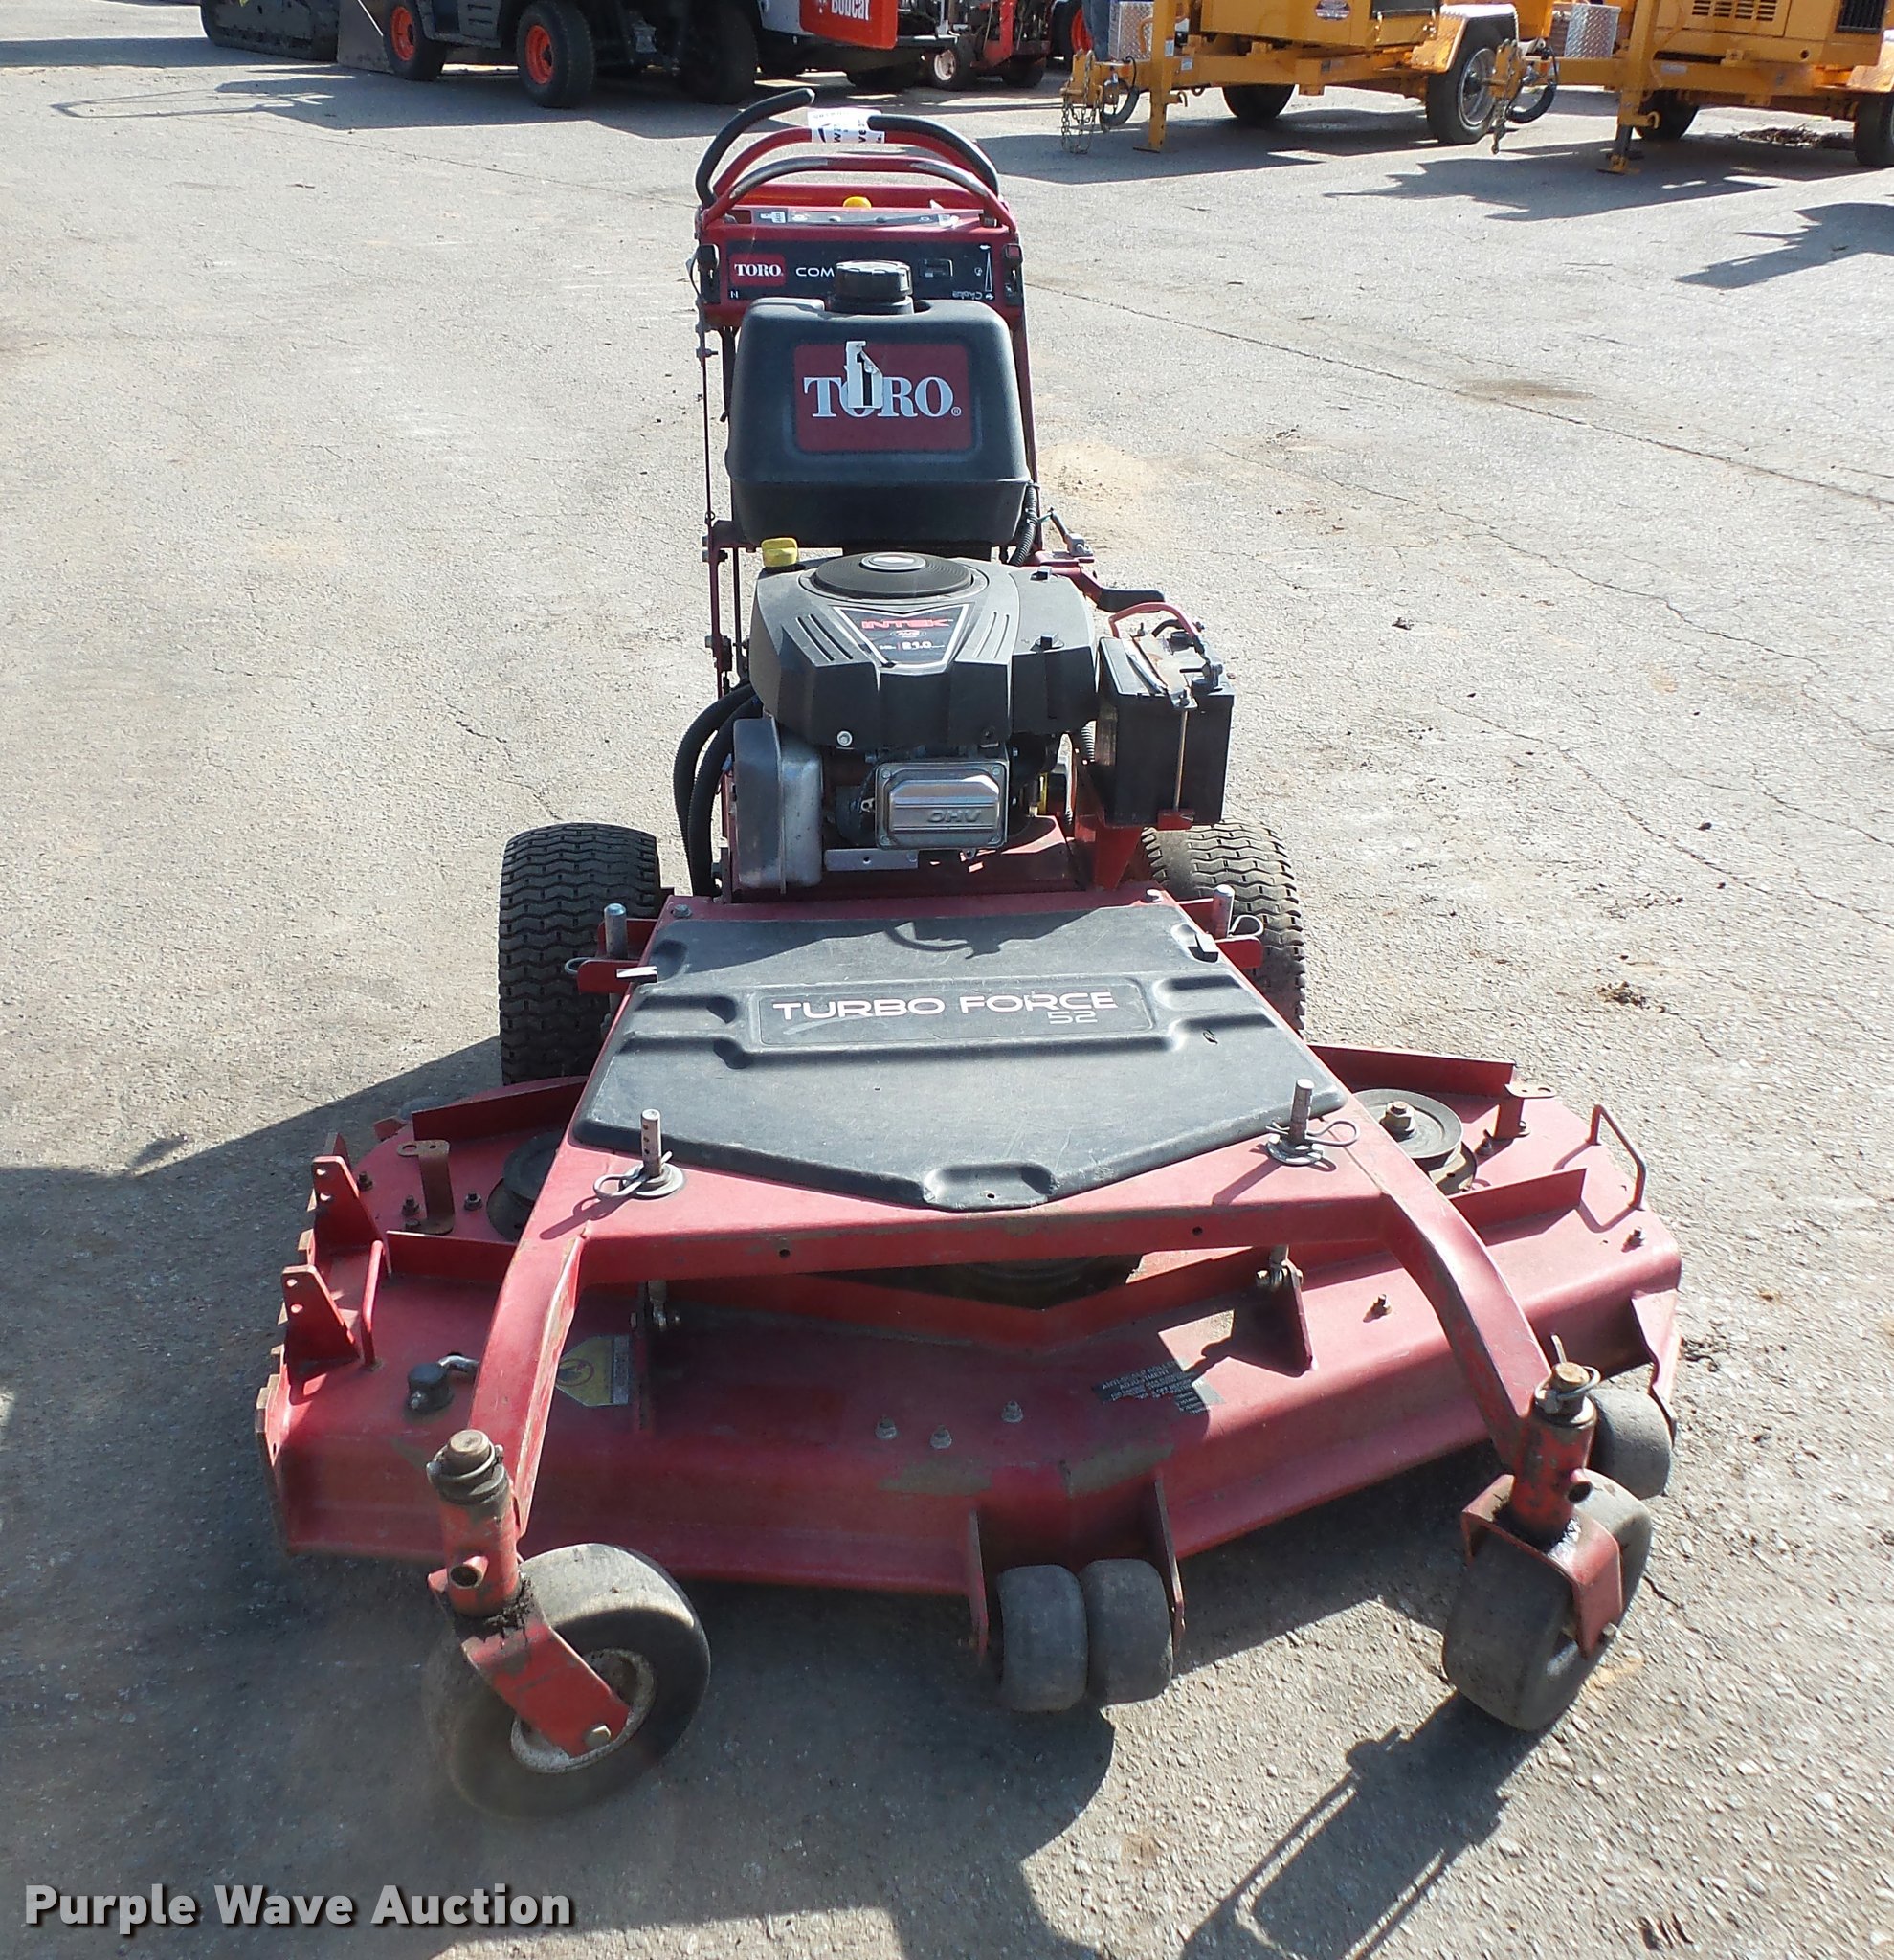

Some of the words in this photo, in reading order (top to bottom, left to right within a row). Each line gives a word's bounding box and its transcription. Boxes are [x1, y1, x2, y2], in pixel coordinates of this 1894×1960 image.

[734, 264, 782, 277] TORO
[861, 618, 950, 629] INTEK
[927, 809, 981, 823] OHV
[772, 997, 946, 1020] TURBO
[959, 991, 1119, 1014] FORCE
[1046, 1011, 1099, 1024] 52
